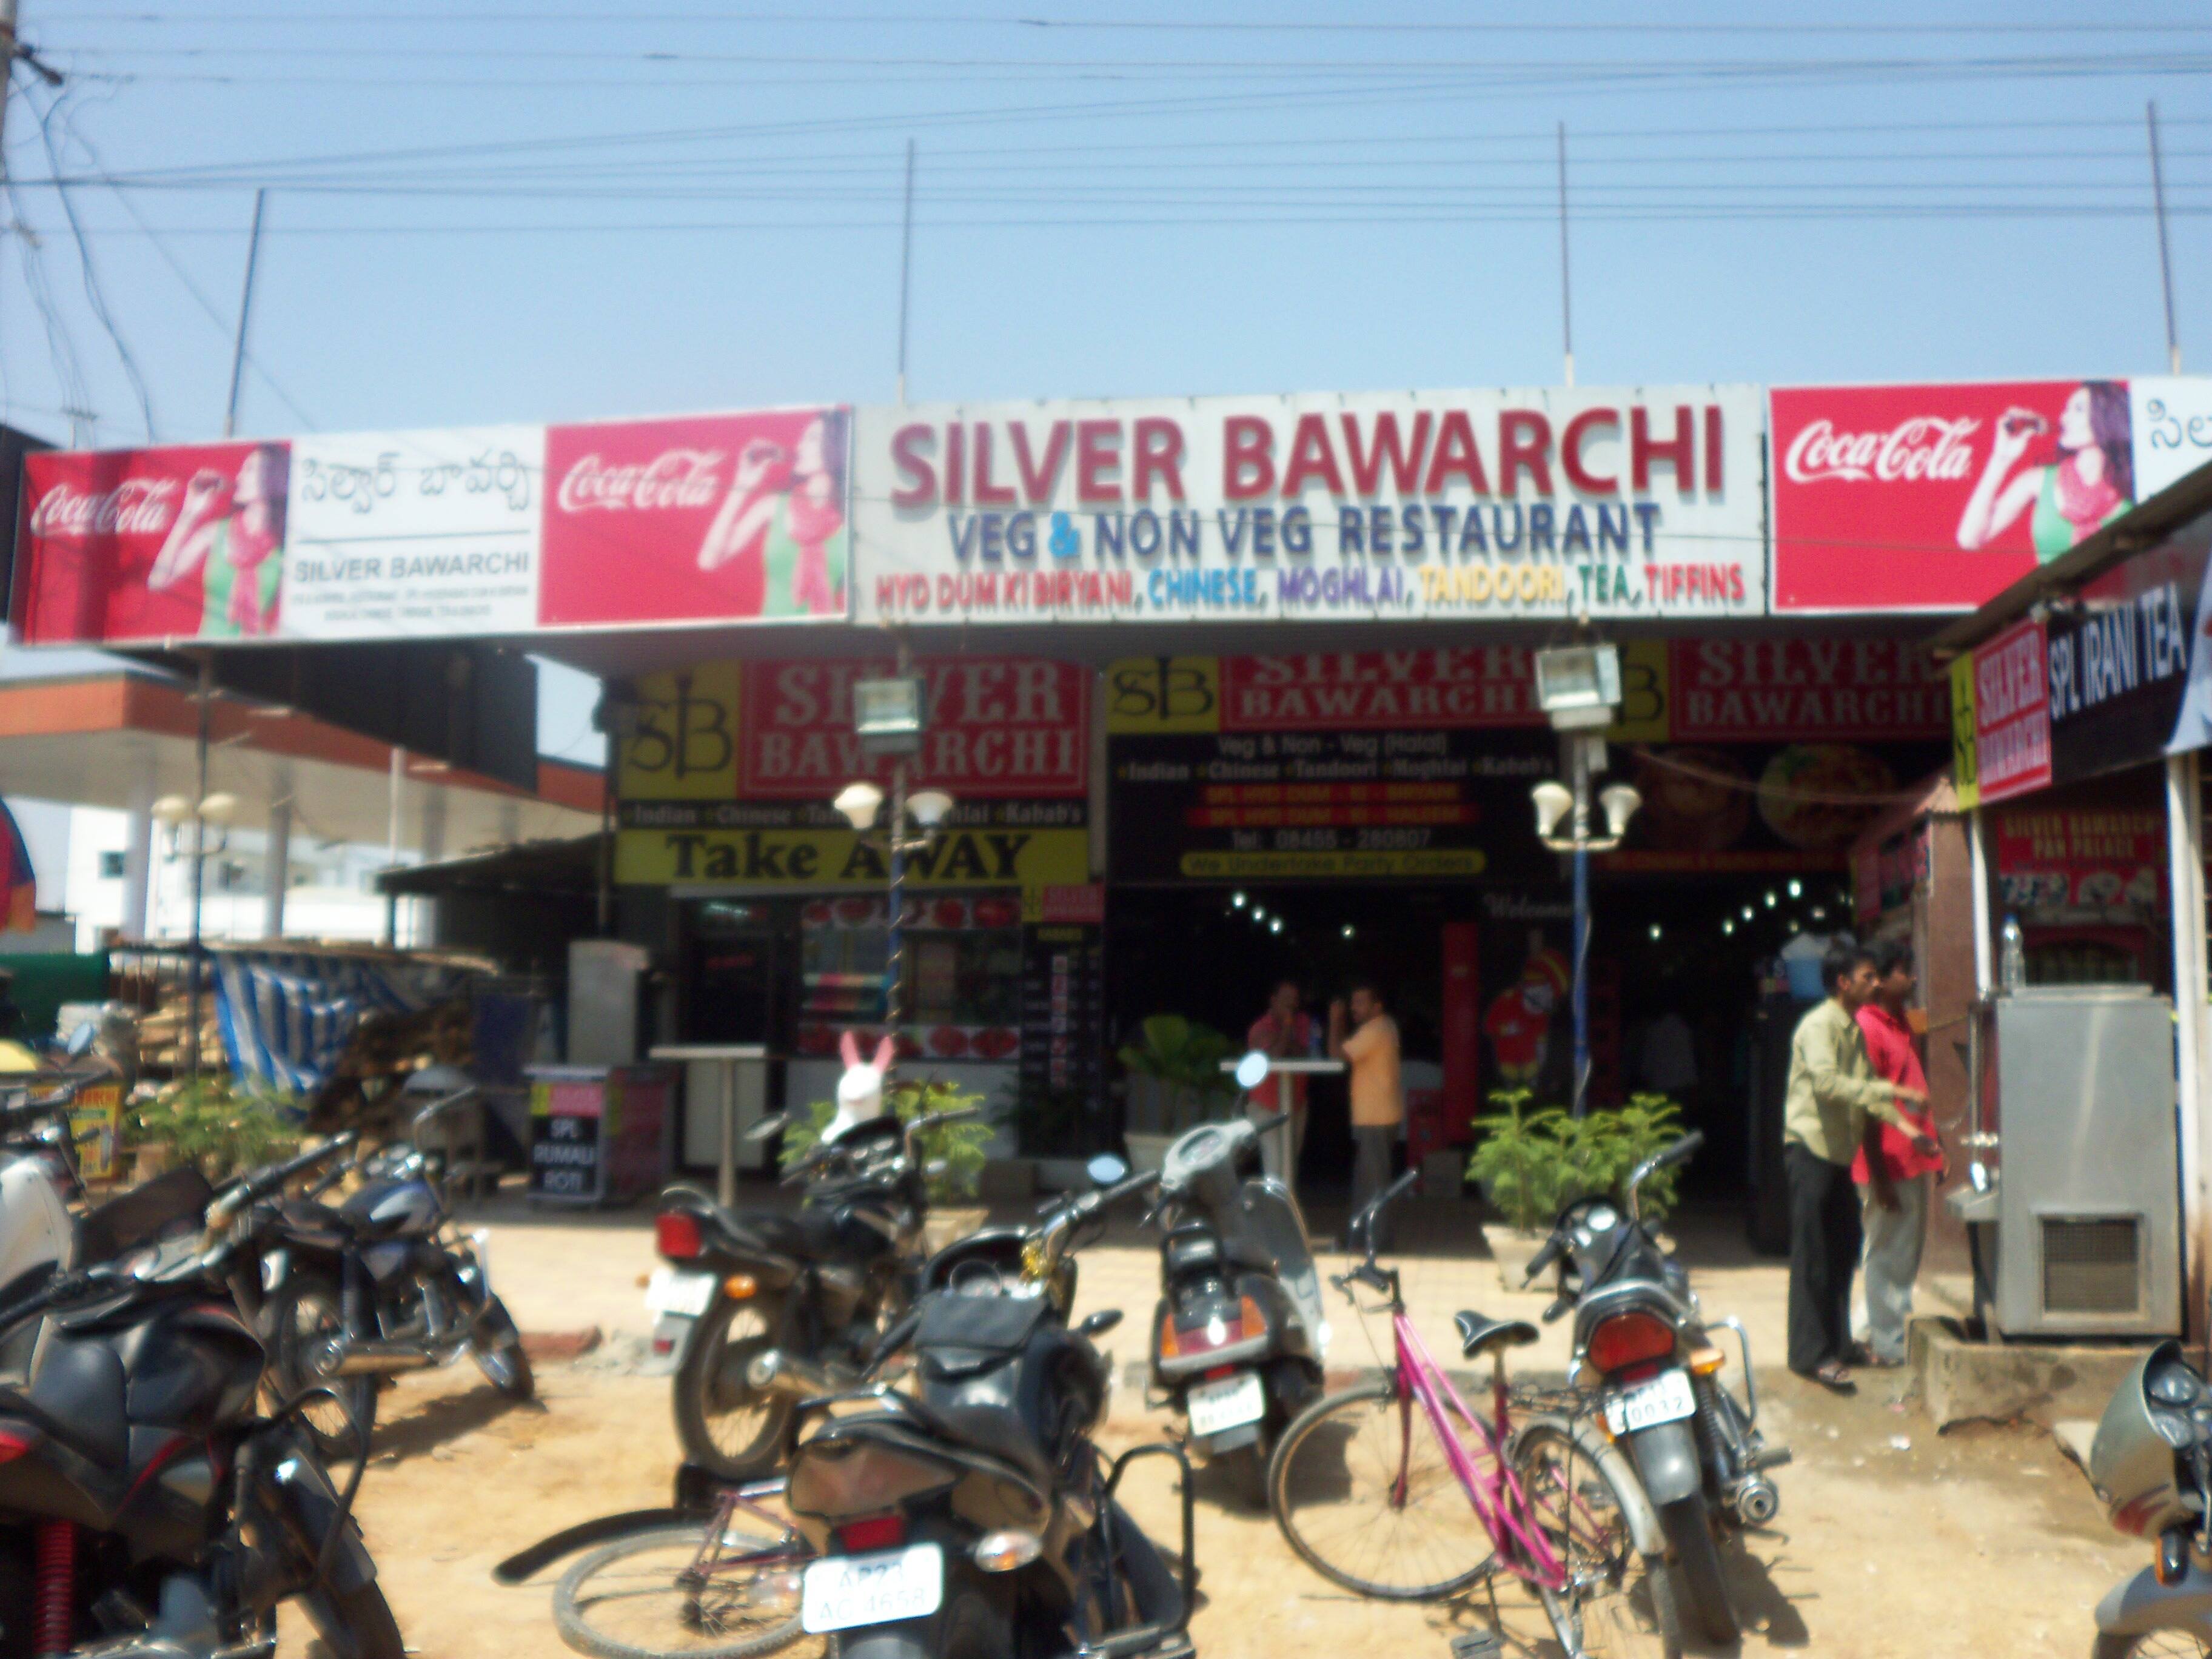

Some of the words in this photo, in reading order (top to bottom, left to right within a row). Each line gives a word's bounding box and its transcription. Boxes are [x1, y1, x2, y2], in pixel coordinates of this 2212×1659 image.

[890, 415, 1187, 507] SILVER
[1223, 405, 1723, 501] BAWARCHI
[1785, 417, 1982, 483] Coca-Cola
[29, 479, 176, 536] Coca-Cola
[559, 448, 726, 512] Coca-Cola
[948, 511, 1037, 563] VEG
[1048, 510, 1080, 558] &
[1095, 509, 1200, 559] NON
[1217, 505, 1312, 557] VEG
[1339, 502, 1661, 554] RESTAURANT
[294, 556, 381, 583] SILVER
[389, 551, 529, 579] BAWARCHI
[876, 572, 930, 608] HYD
[937, 572, 997, 606] DUM
[1004, 571, 1028, 605] KI
[1644, 562, 1745, 603] TIFFINS
[2083, 600, 2139, 707] IRANI
[2142, 580, 2187, 683] TEA
[776, 661, 1062, 725] SIVER
[1128, 763, 1189, 780] Indian
[1207, 762, 1279, 779] Chinese
[1218, 736, 1255, 758] Veg
[1282, 735, 1321, 753] Non
[1341, 734, 1377, 757] Veg
[635, 806, 697, 825] Indian
[717, 805, 791, 825] Chinese
[665, 834, 819, 879] Take
[840, 834, 1032, 879] AWAY
